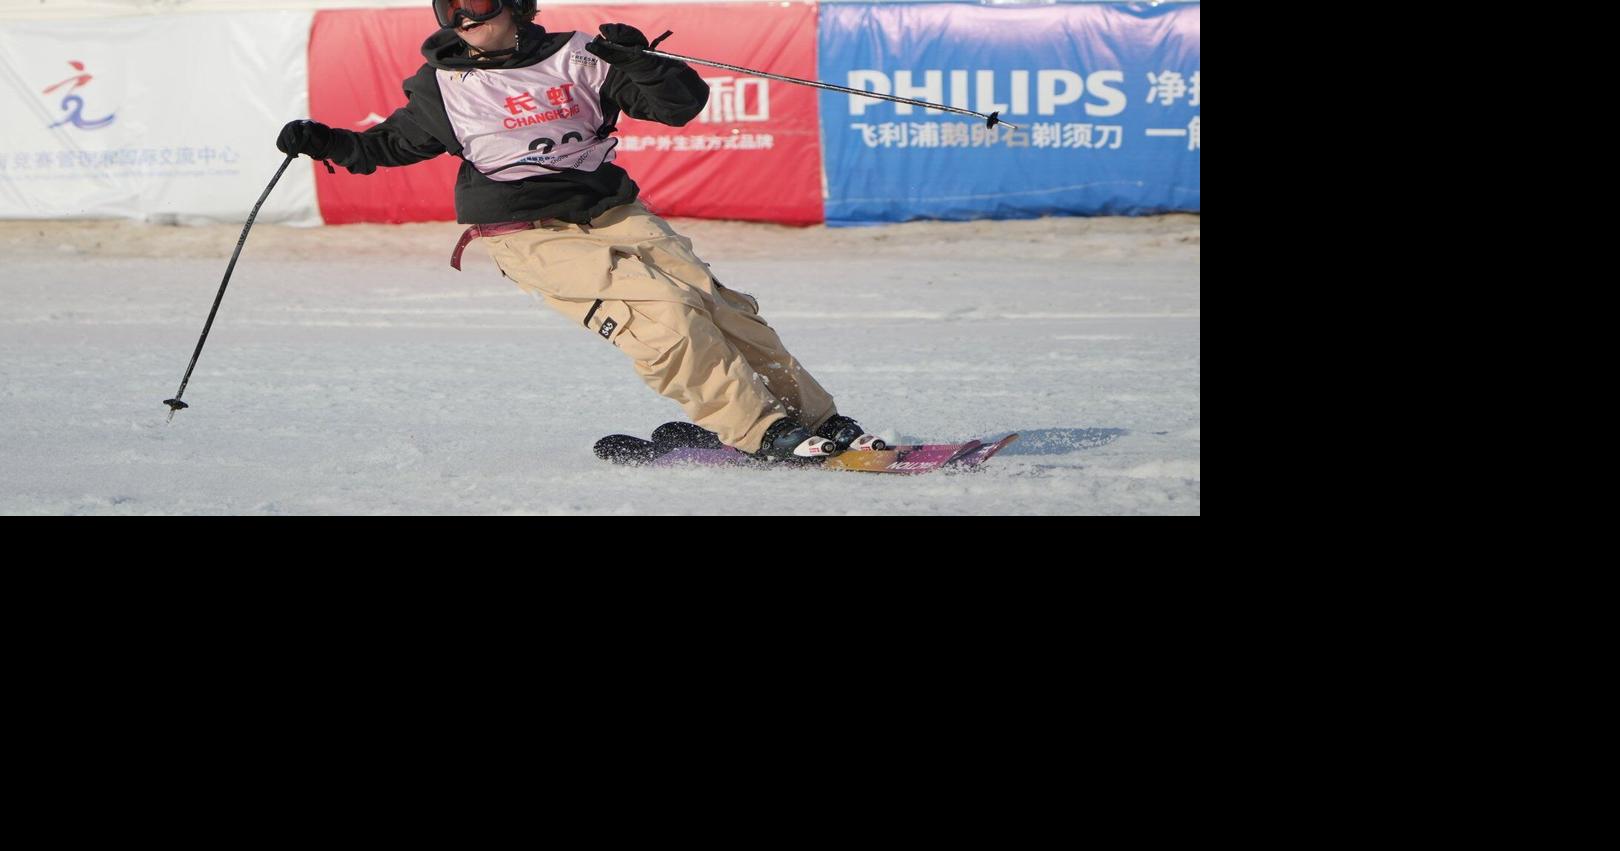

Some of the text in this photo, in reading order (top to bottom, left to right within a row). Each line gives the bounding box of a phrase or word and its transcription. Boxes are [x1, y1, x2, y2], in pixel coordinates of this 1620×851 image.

[847, 70, 1127, 117] PHILIPS
[503, 104, 580, 129] CHANGHONG
[851, 122, 1123, 149] 飞利浦鹅卵石剃须刀
